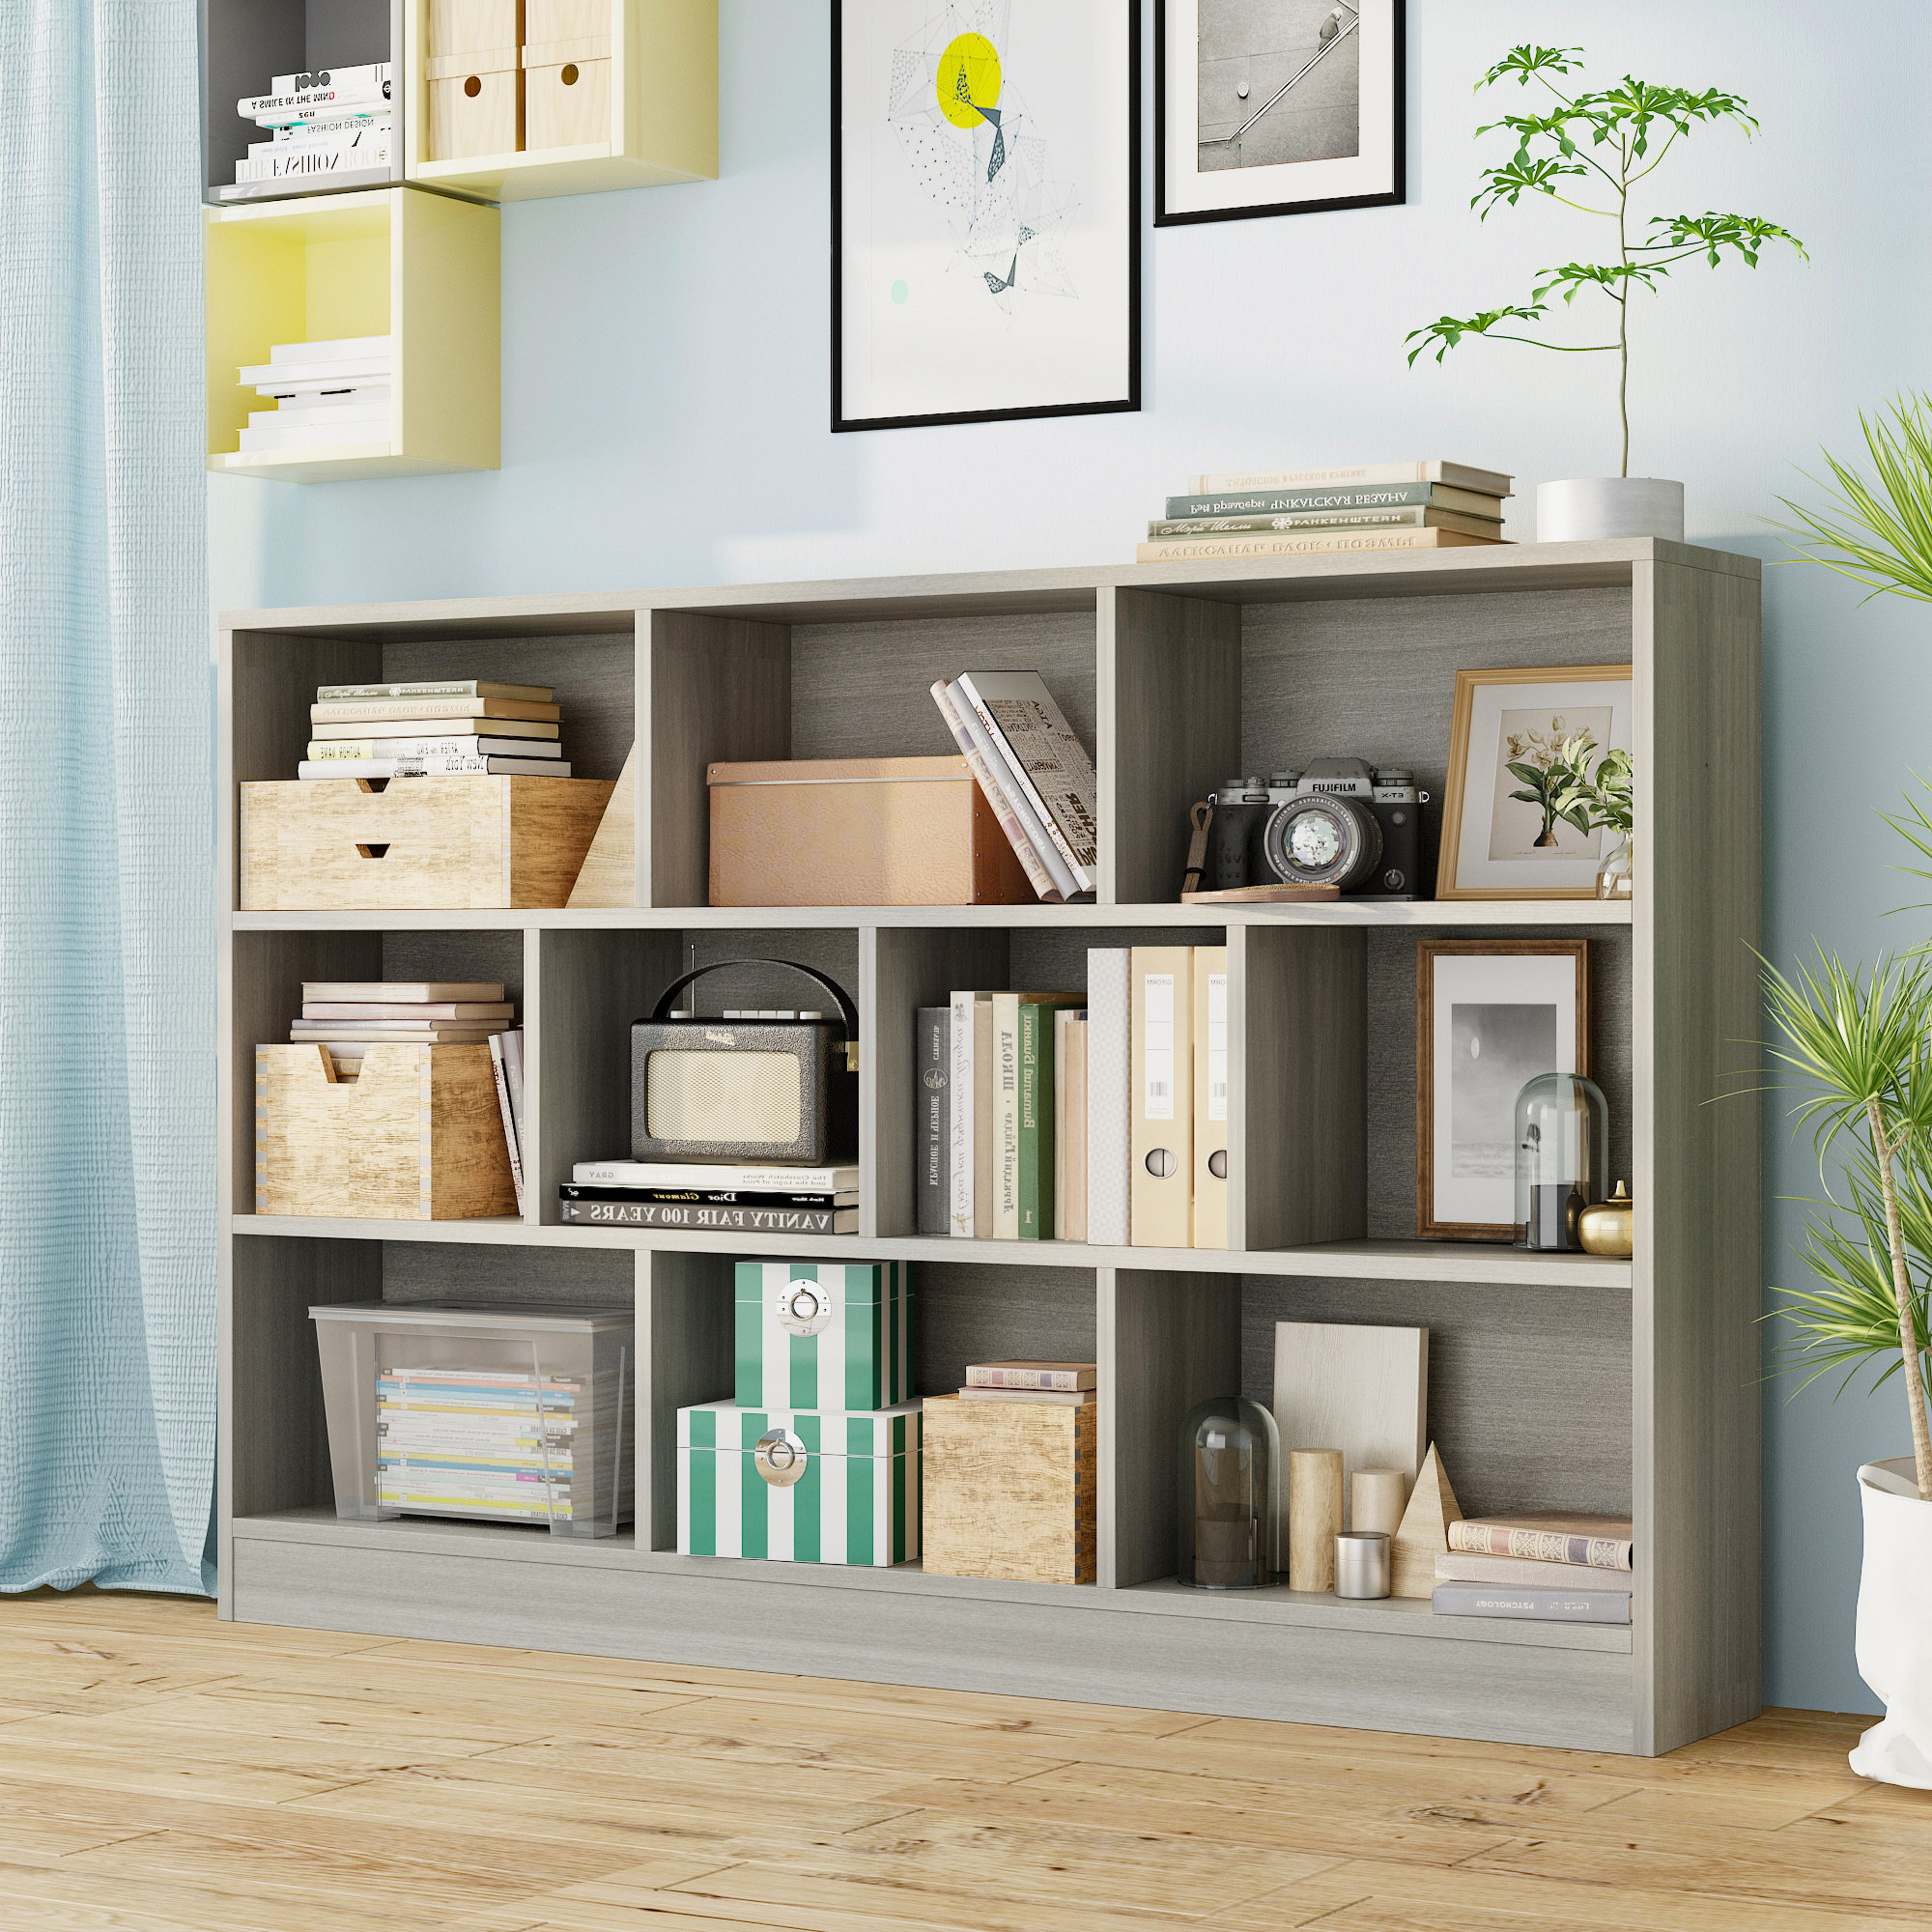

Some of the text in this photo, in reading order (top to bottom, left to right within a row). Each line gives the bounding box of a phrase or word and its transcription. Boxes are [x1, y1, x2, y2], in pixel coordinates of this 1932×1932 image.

[1159, 537, 1414, 557] АЛЕКСАНДР БЛОК ПОЭМЫ
[1313, 782, 1356, 792] FUJIFILM
[1274, 796, 1352, 827] FUJINON ASPHERICAL LENS
[1476, 1600, 1534, 1609] PSYCHOLOGY
